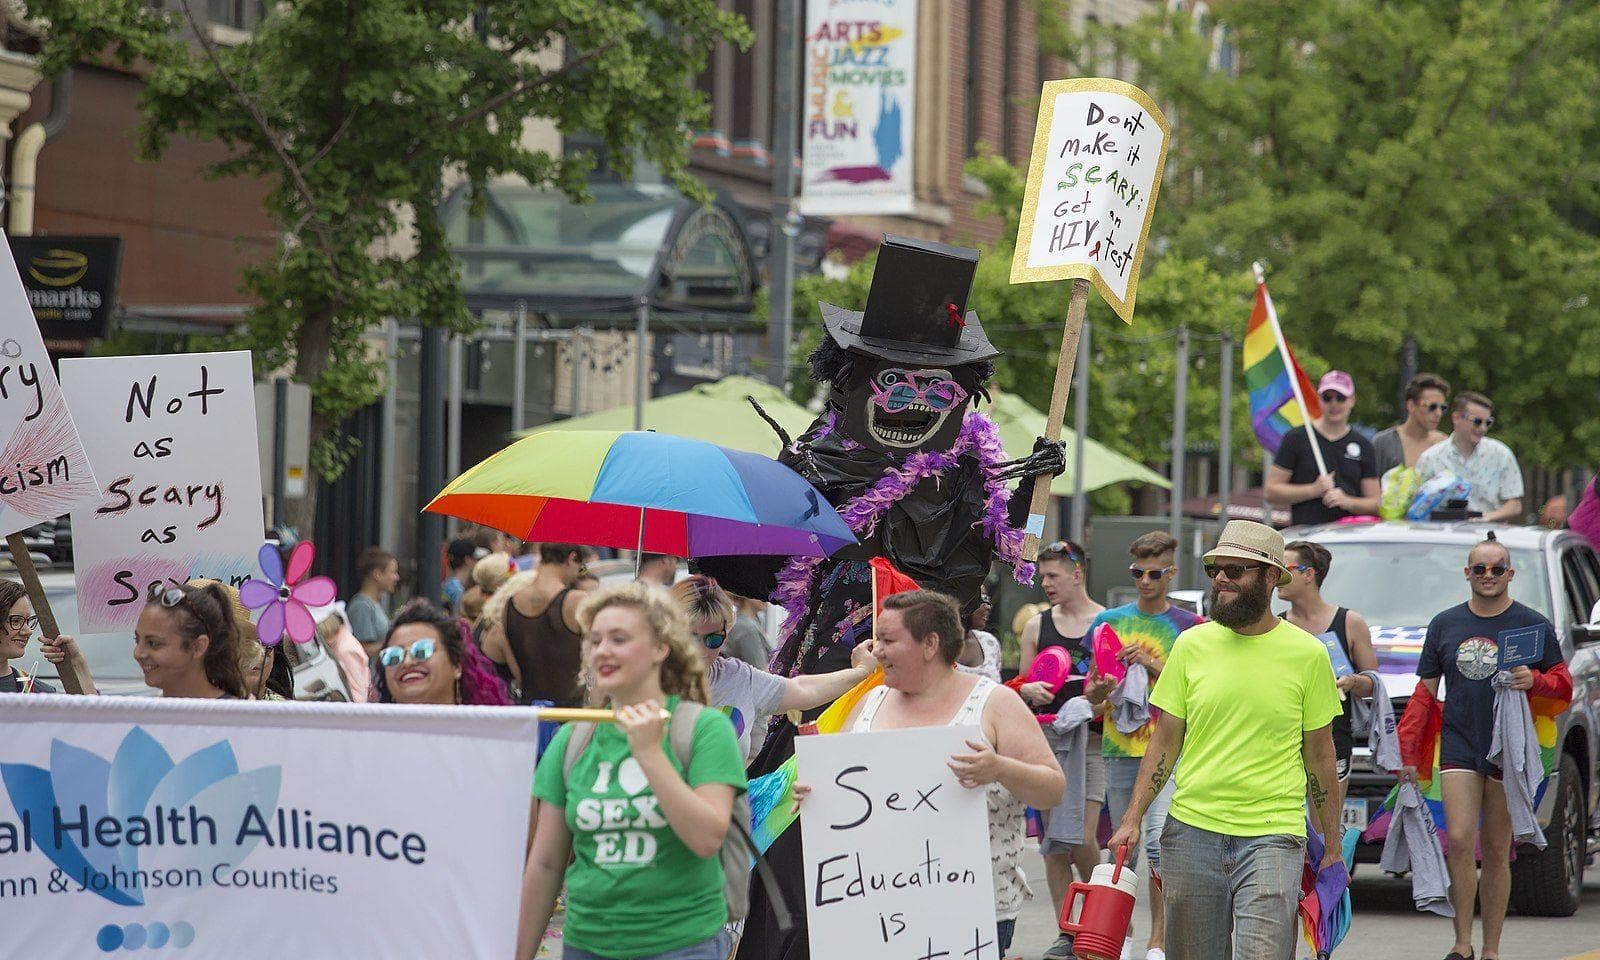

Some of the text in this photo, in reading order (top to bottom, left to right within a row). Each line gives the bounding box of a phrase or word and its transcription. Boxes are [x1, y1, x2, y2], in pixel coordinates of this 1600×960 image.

[815, 20, 882, 42] ARTS
[830, 46, 889, 67] JAZZ
[829, 68, 906, 86] MOVIES
[831, 90, 852, 117] &
[808, 121, 858, 140] FUN
[1126, 144, 1140, 166] it
[1053, 190, 1092, 218] Get
[1048, 219, 1134, 277] HIV test
[125, 365, 225, 424] Not
[133, 436, 173, 459] as
[97, 476, 223, 529] Scary
[141, 525, 177, 544] as
[591, 761, 614, 794] I
[575, 795, 668, 831] SEX
[830, 765, 943, 830] Sex
[52, 804, 218, 850] Health
[235, 804, 427, 865] Alliance
[592, 831, 658, 864] ED
[47, 867, 69, 894] &
[76, 864, 202, 892] Johnson
[212, 863, 339, 895] Counties
[815, 840, 976, 907] Education
[879, 912, 906, 942] is
